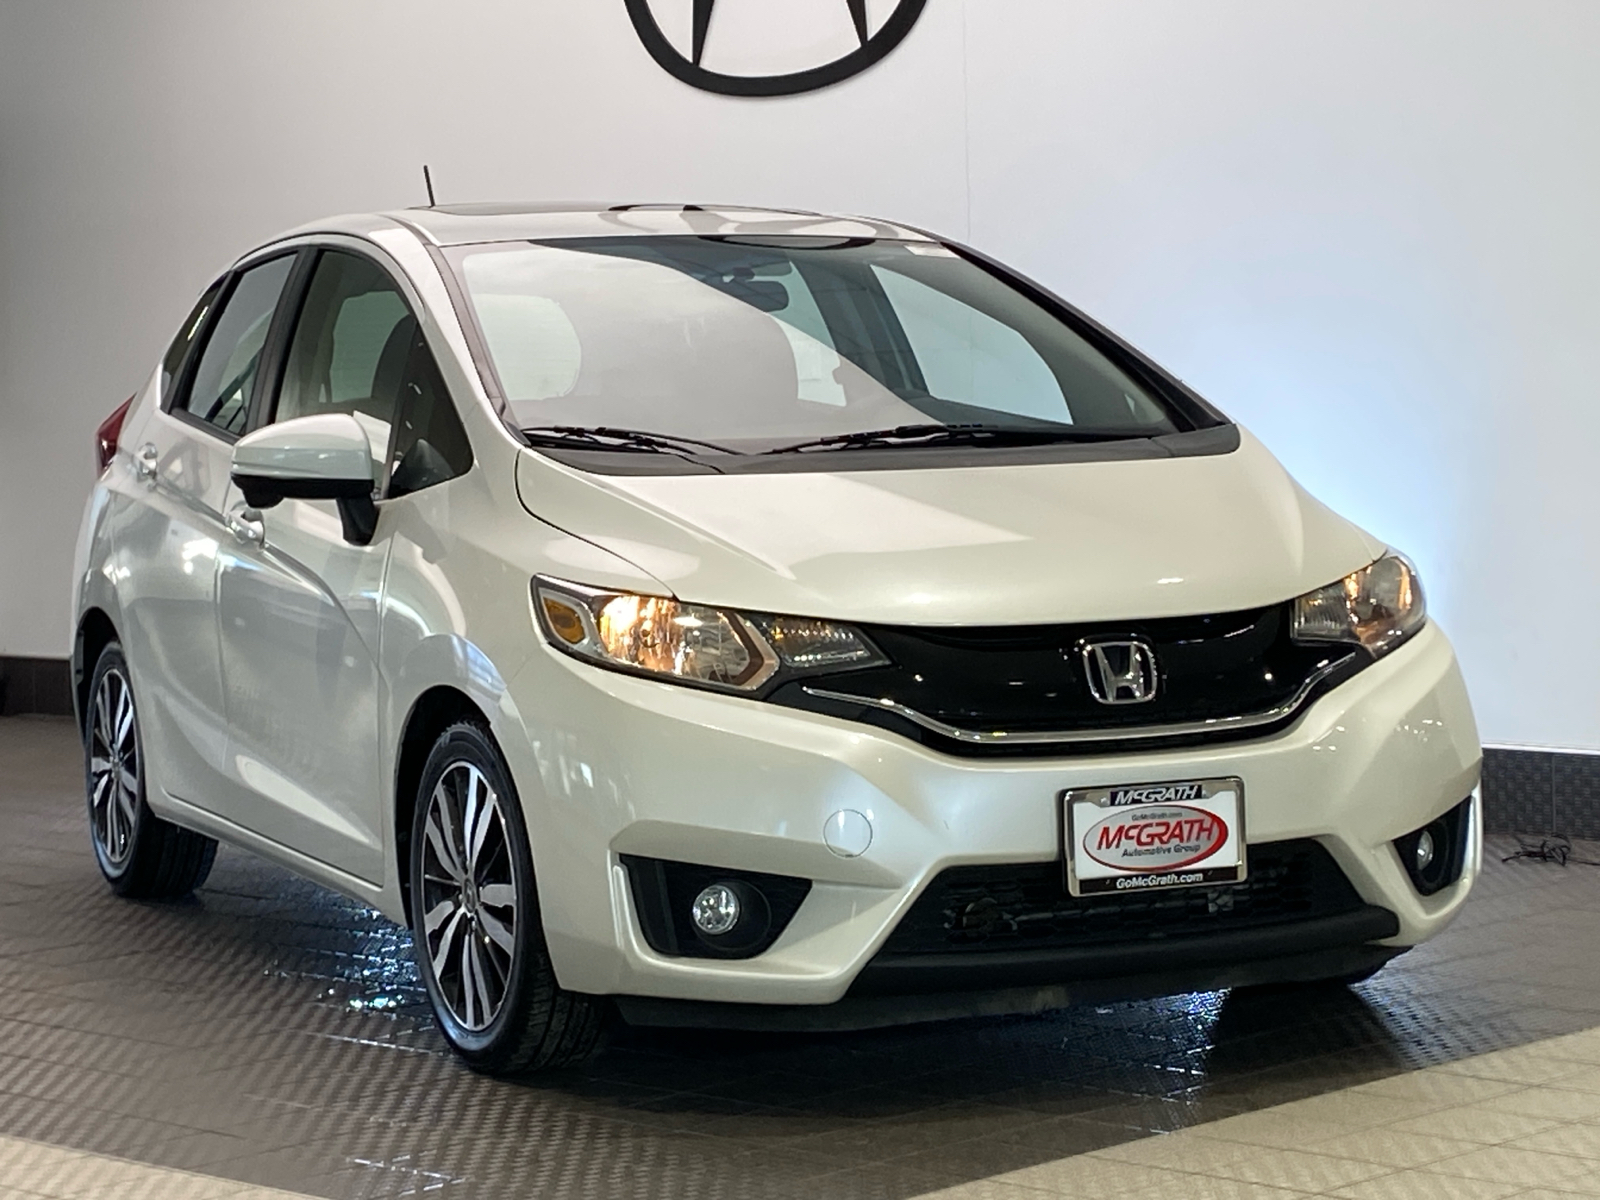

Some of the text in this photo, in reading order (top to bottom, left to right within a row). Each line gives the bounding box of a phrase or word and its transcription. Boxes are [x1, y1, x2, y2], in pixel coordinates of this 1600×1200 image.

[1122, 844, 1201, 857] Automotive Group
[1116, 872, 1203, 889] GoMcGrath.com
